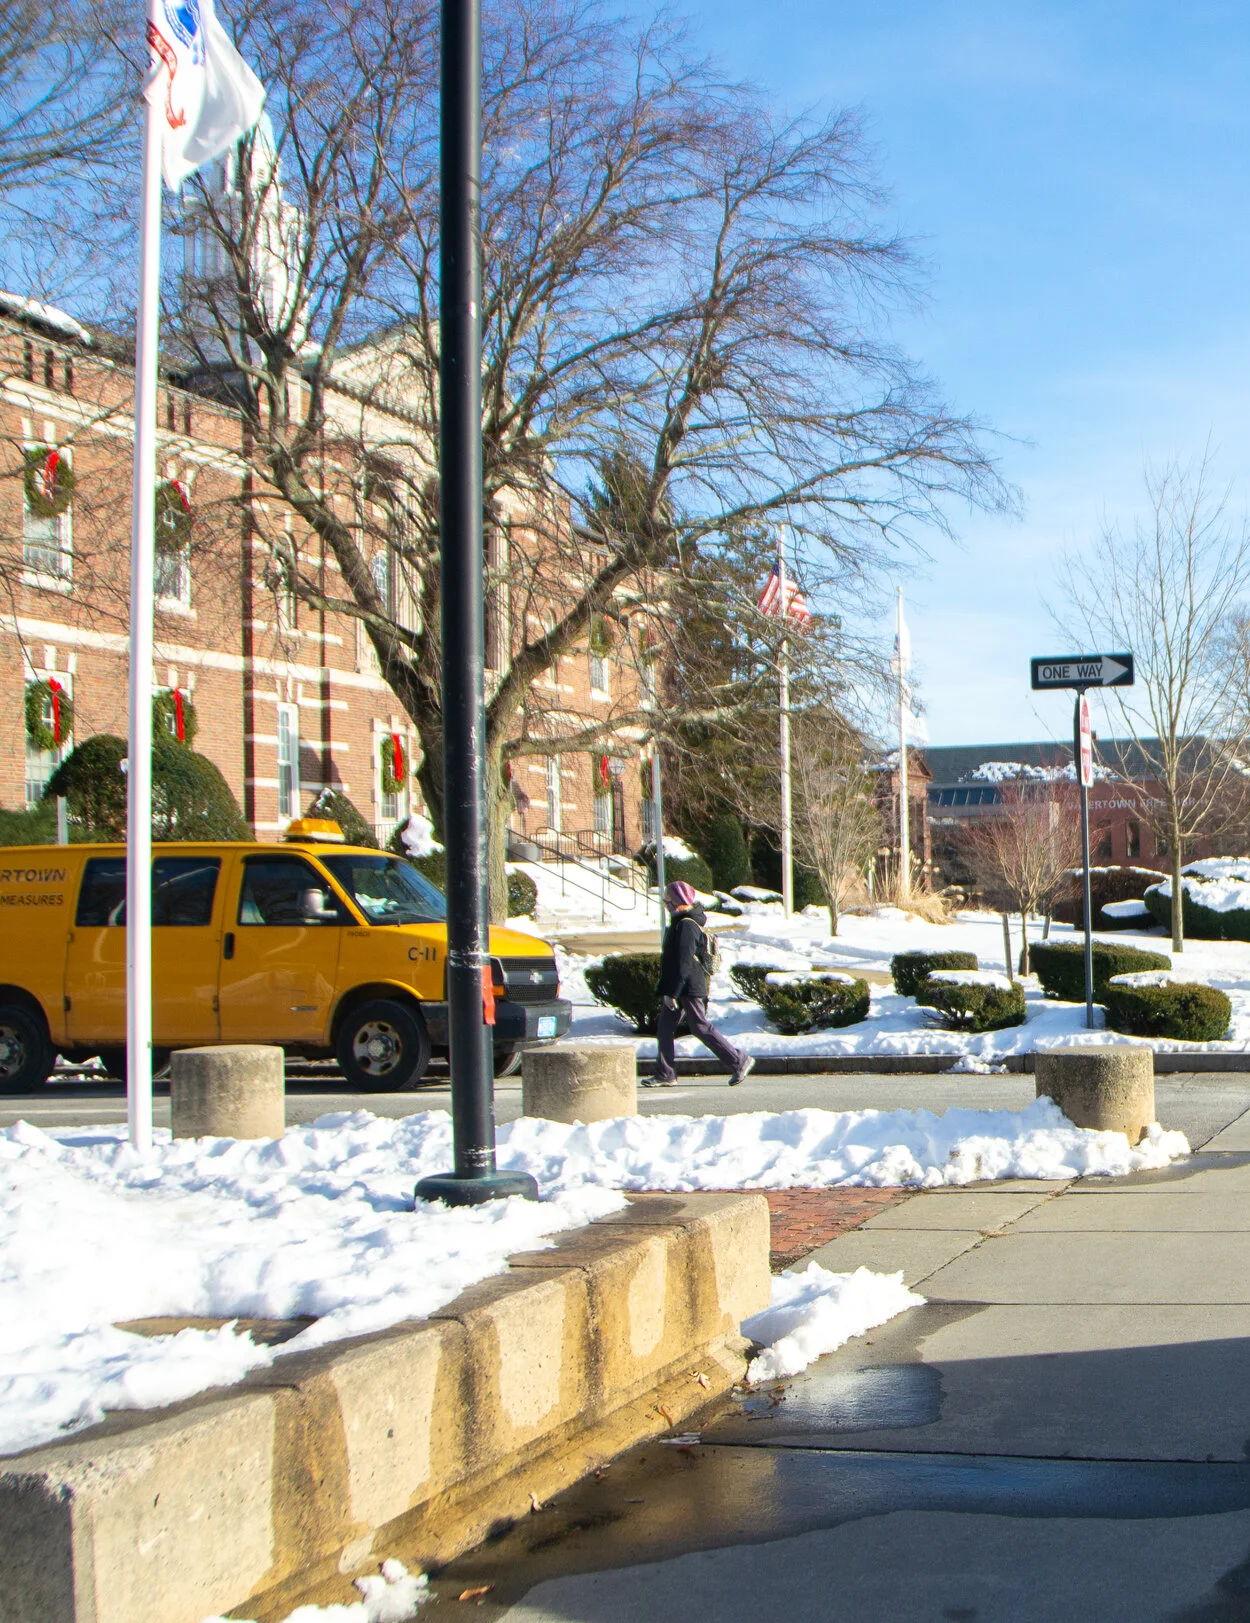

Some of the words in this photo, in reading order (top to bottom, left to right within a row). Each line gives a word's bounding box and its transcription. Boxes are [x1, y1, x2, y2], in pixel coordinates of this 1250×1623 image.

[1042, 665, 1071, 680] ONE
[1076, 664, 1103, 678] WAY
[0, 894, 64, 906] MEASURES
